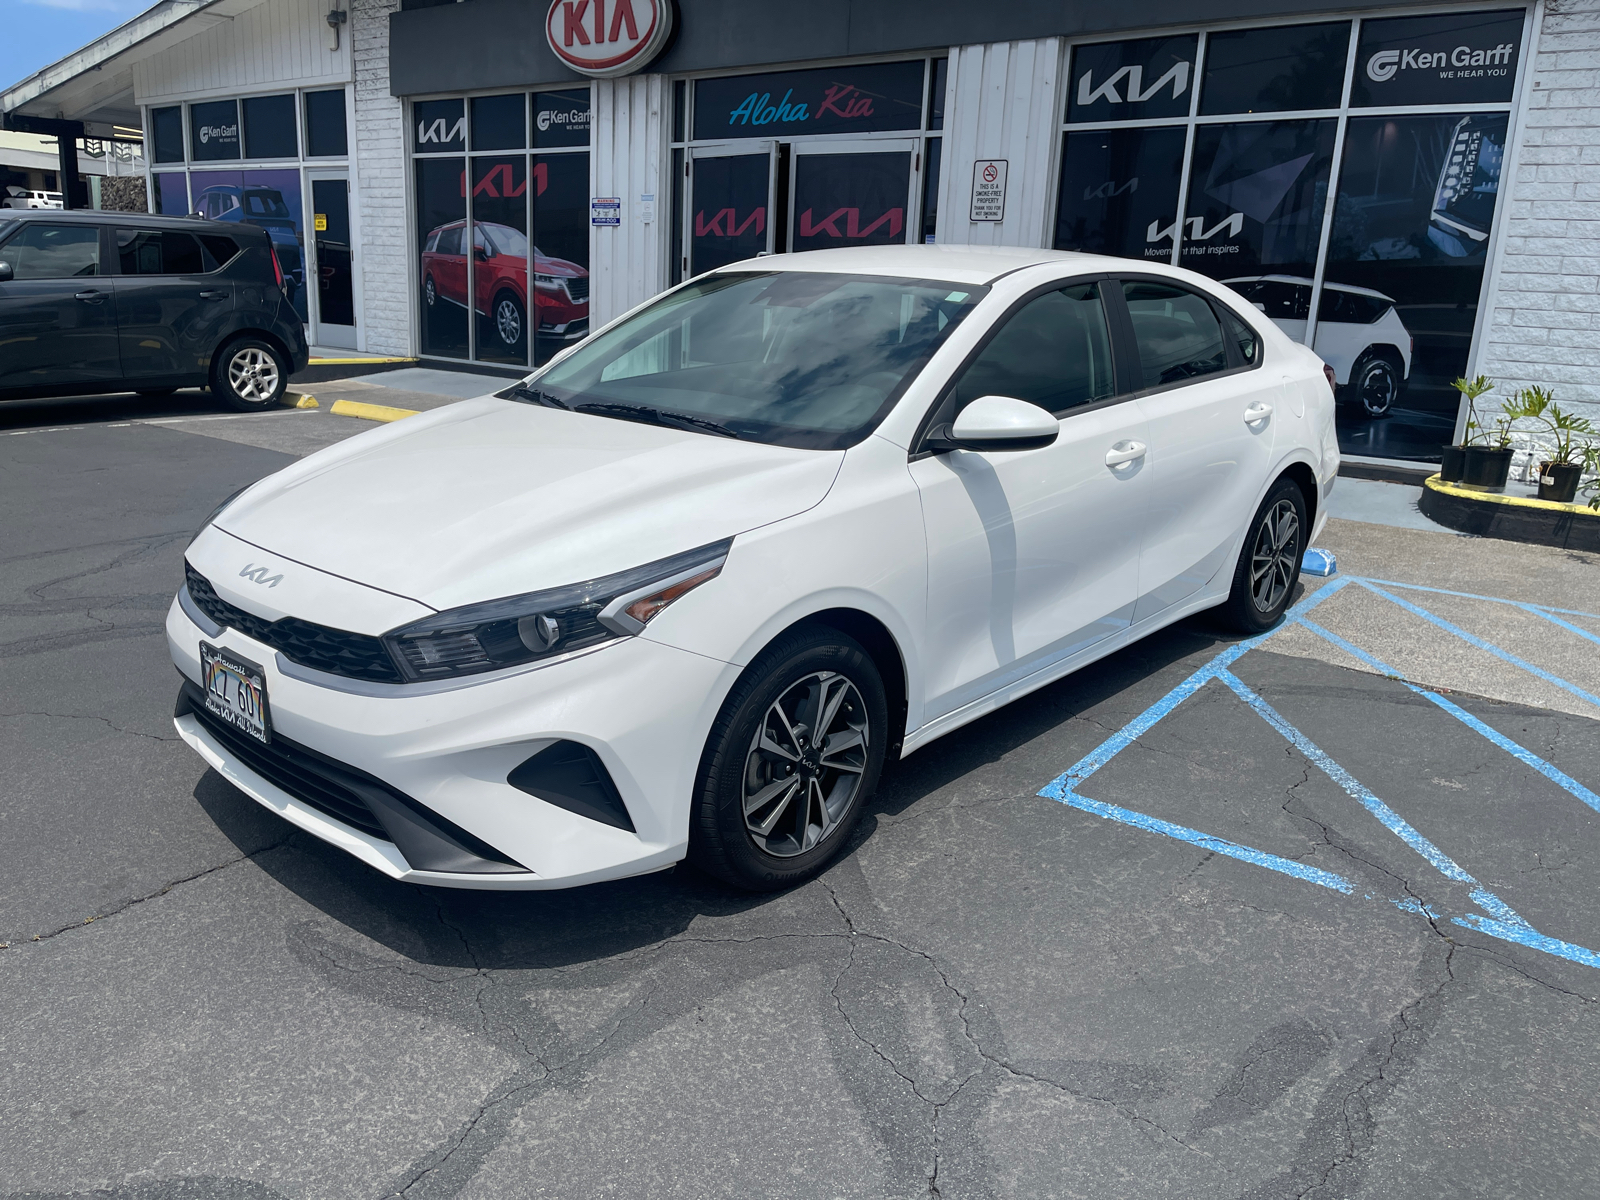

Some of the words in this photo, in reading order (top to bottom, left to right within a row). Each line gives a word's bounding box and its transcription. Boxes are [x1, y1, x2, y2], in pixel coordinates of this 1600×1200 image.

[562, 0, 639, 47] KIA
[1401, 49, 1447, 70] Ken
[1451, 43, 1514, 67] Garff
[1077, 61, 1190, 106] KIA
[1440, 71, 1454, 79] WE
[1457, 70, 1484, 78] HEAR
[1487, 68, 1507, 76] YOU
[550, 110, 569, 124] Ken
[570, 109, 591, 123] Garf
[729, 88, 810, 125] Aloha
[815, 84, 875, 119] Kia
[208, 126, 221, 138] Ken
[221, 124, 237, 137] Garff
[418, 117, 466, 144] KIA
[460, 163, 548, 198] KIA
[1083, 177, 1139, 201] KIA
[696, 206, 765, 237] KIA
[800, 206, 903, 238] KIA
[1146, 212, 1244, 242] KIA
[1144, 247, 1189, 257] Movemnt
[1190, 246, 1207, 255] that
[1207, 244, 1240, 256] inspires
[239, 562, 284, 588] KIA
[214, 653, 246, 676] Hawaii
[238, 679, 262, 722] 607
[205, 698, 221, 716] Aloha
[220, 707, 236, 724] KIA
[236, 717, 246, 731] All
[246, 721, 267, 743] Islands
